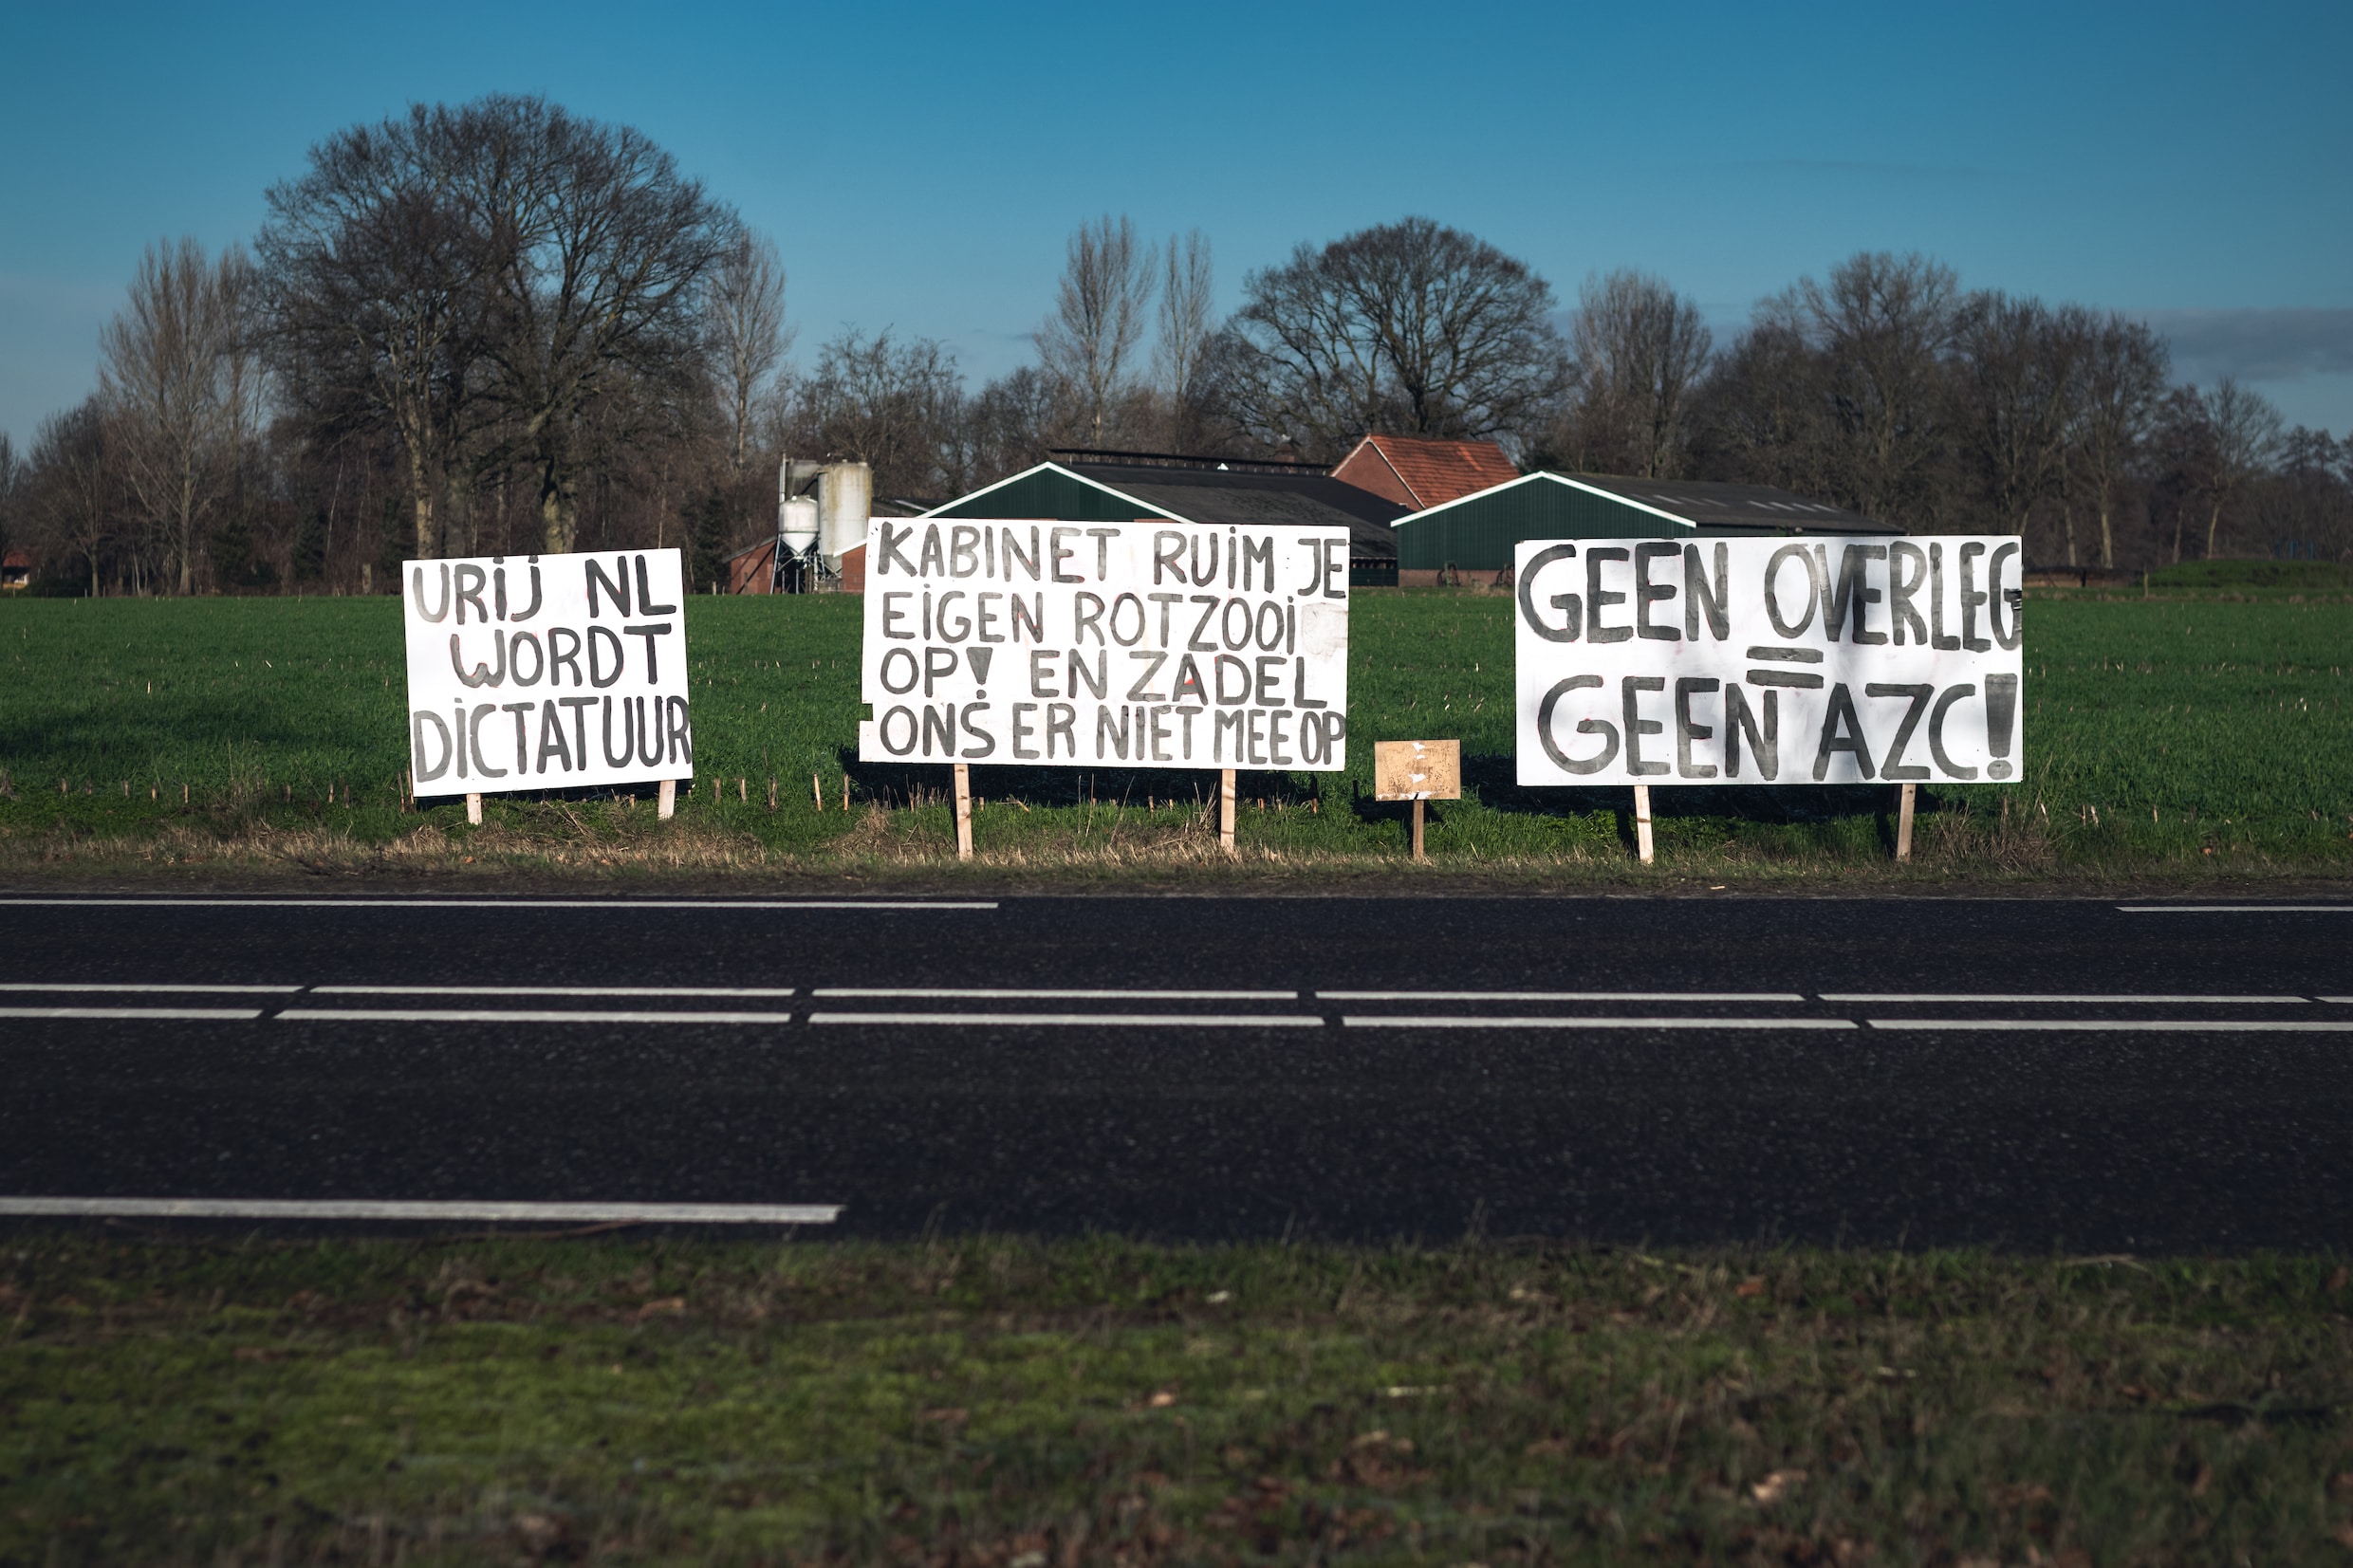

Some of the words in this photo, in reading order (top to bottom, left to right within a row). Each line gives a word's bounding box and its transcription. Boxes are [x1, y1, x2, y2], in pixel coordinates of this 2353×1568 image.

[585, 554, 676, 618] NL
[878, 521, 1121, 582] KABINET
[1297, 538, 1347, 599] JE
[1518, 542, 1730, 644] GEEN
[1764, 541, 2023, 652] OVERLEG
[450, 622, 672, 688] WORDT
[880, 647, 993, 699] OP!
[1030, 650, 1107, 699] EN
[1126, 651, 1327, 709] ZADEL
[880, 702, 996, 758] ONS
[1011, 702, 1076, 760] ER
[1096, 705, 1203, 761] NIET
[1538, 674, 1779, 782] GEEN
[1812, 672, 2019, 782] AZC!
